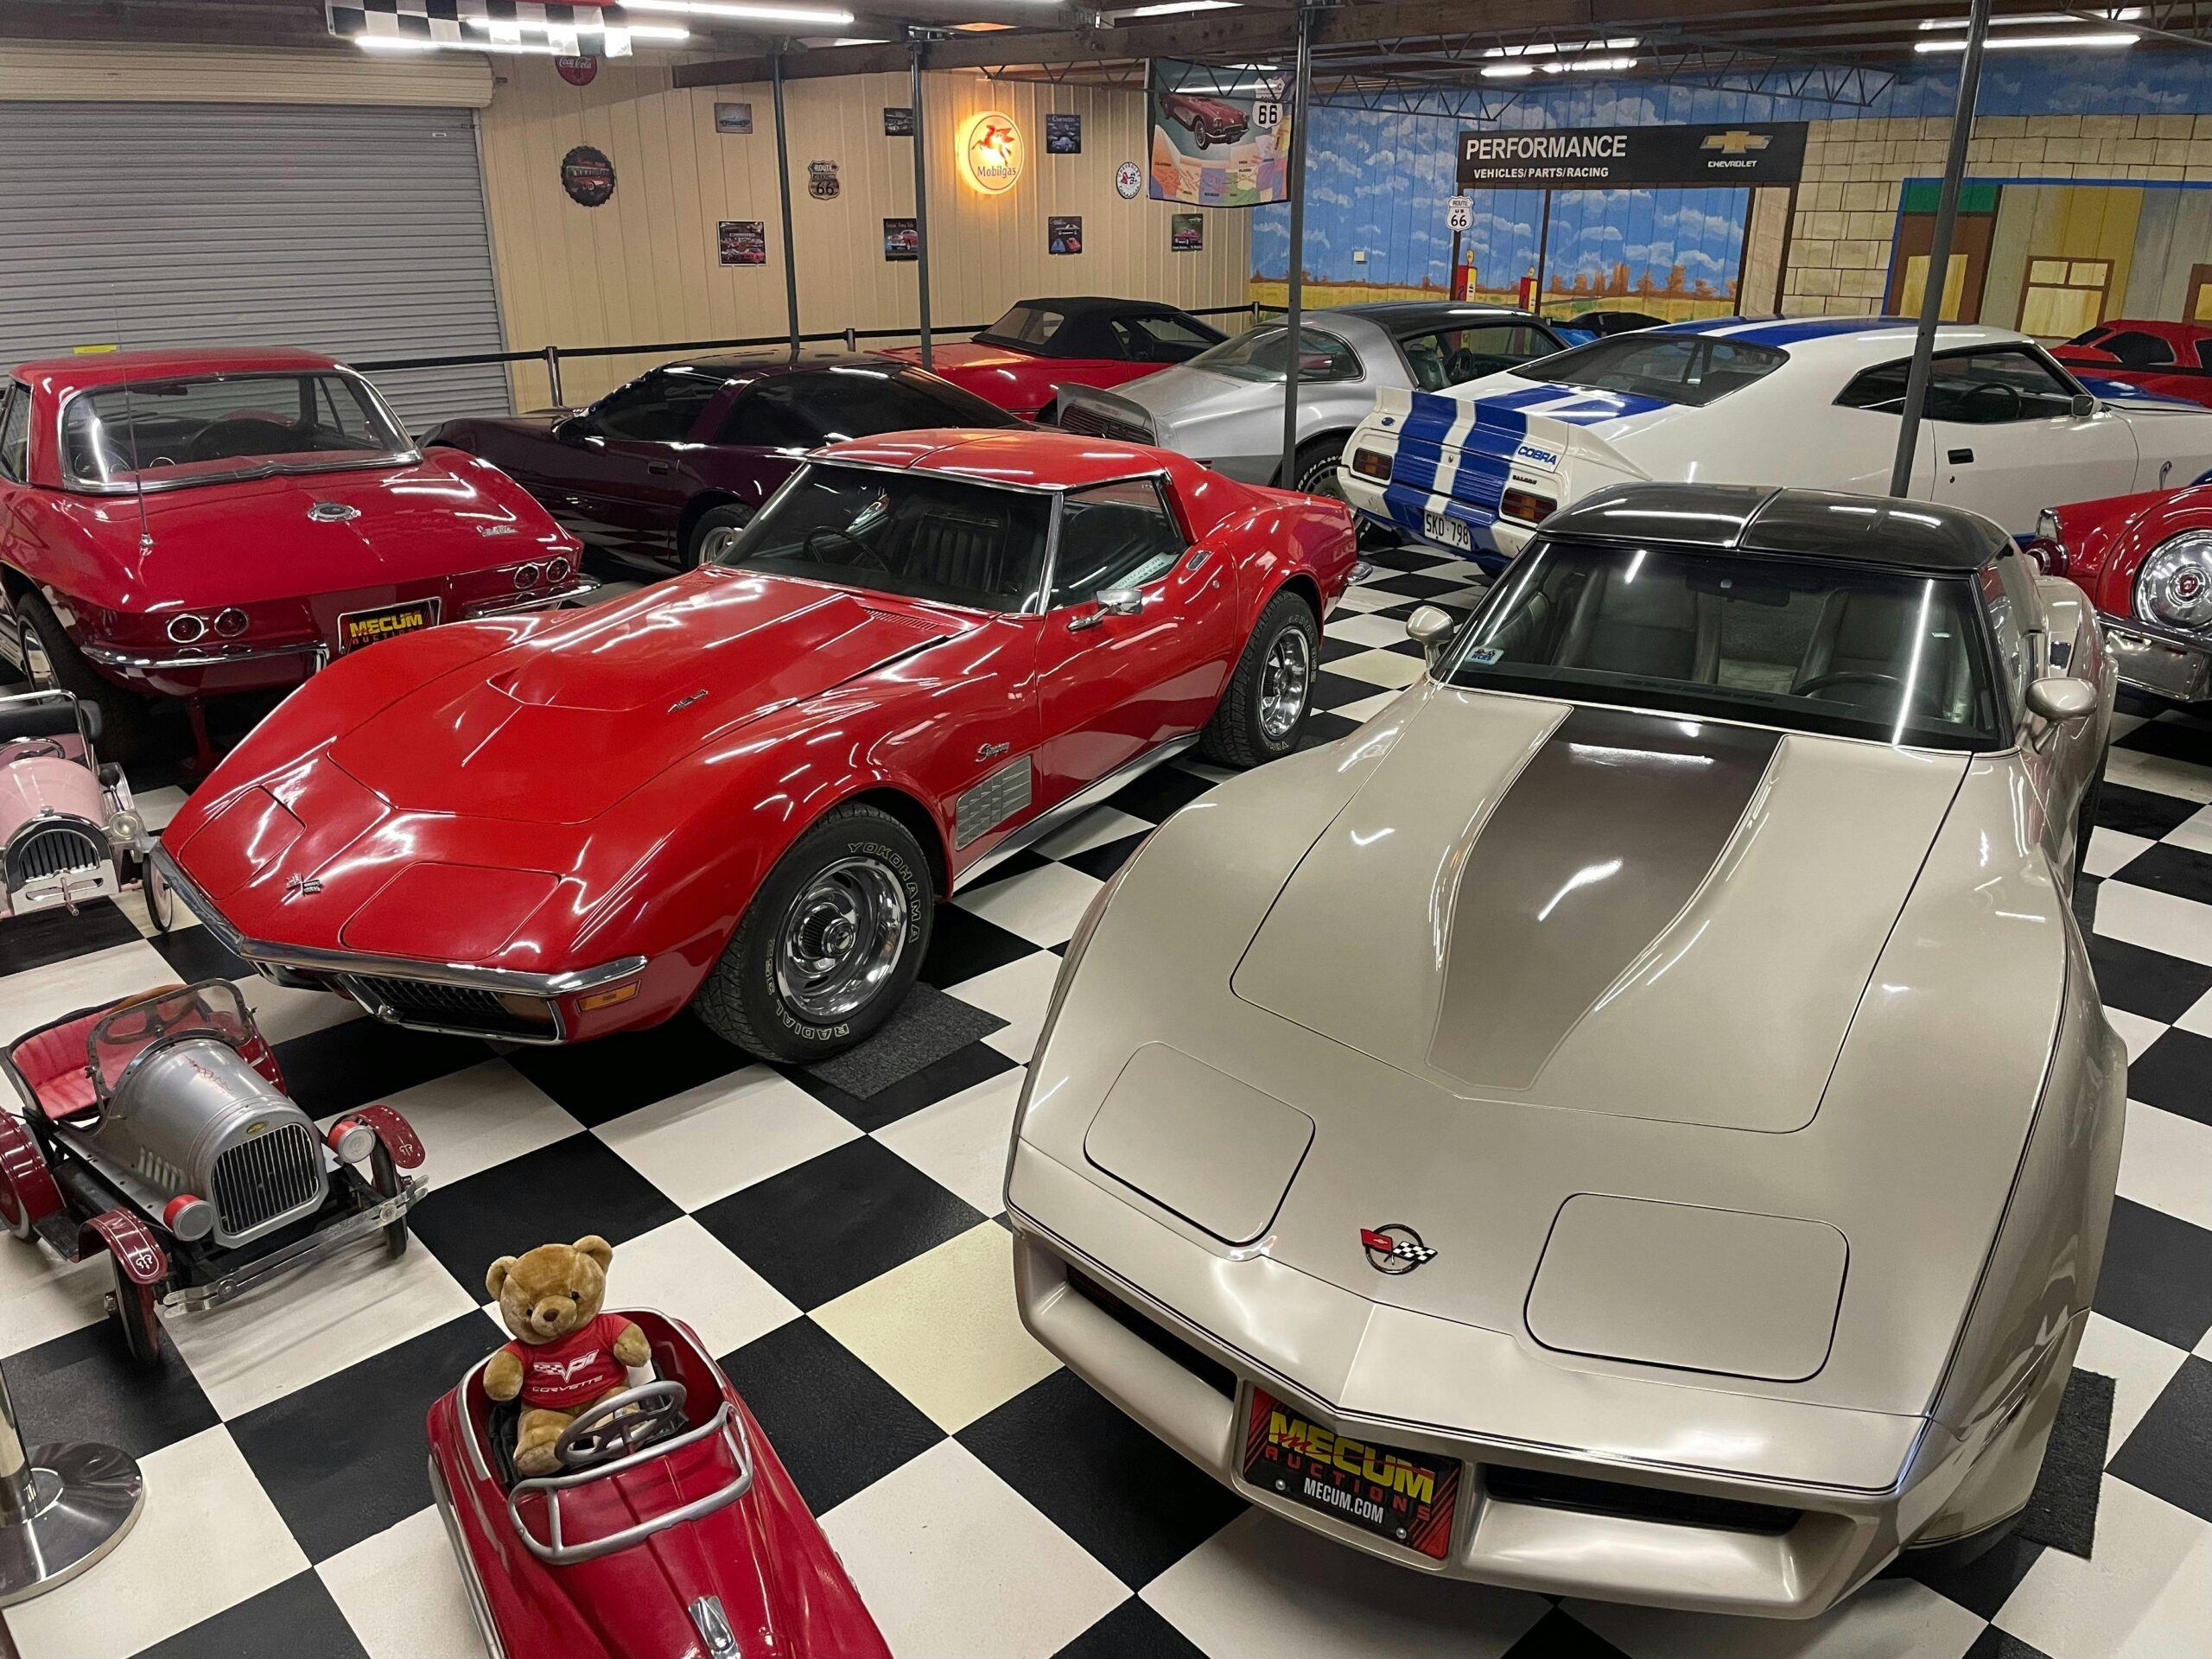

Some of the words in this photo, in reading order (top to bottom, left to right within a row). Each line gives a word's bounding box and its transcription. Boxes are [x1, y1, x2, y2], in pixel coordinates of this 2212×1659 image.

[1258, 105, 1278, 124] 66
[1466, 135, 1628, 160] PERFORMANCE
[977, 166, 1016, 178] Mobilgas
[817, 181, 834, 195] 66
[1451, 214, 1467, 226] 66
[1518, 446, 1557, 465] COBRA
[1426, 513, 1444, 537] SKD
[1451, 521, 1469, 544] 798
[349, 610, 423, 638] MECUM
[848, 842, 922, 944] YOKOHAMA
[776, 998, 850, 1041] RADIAL
[532, 1375, 604, 1393] CORVETTE
[1268, 1410, 1436, 1504] MECUM
[1265, 1445, 1431, 1522] AUCTIONS
[1303, 1477, 1384, 1524] MECUM.COM
